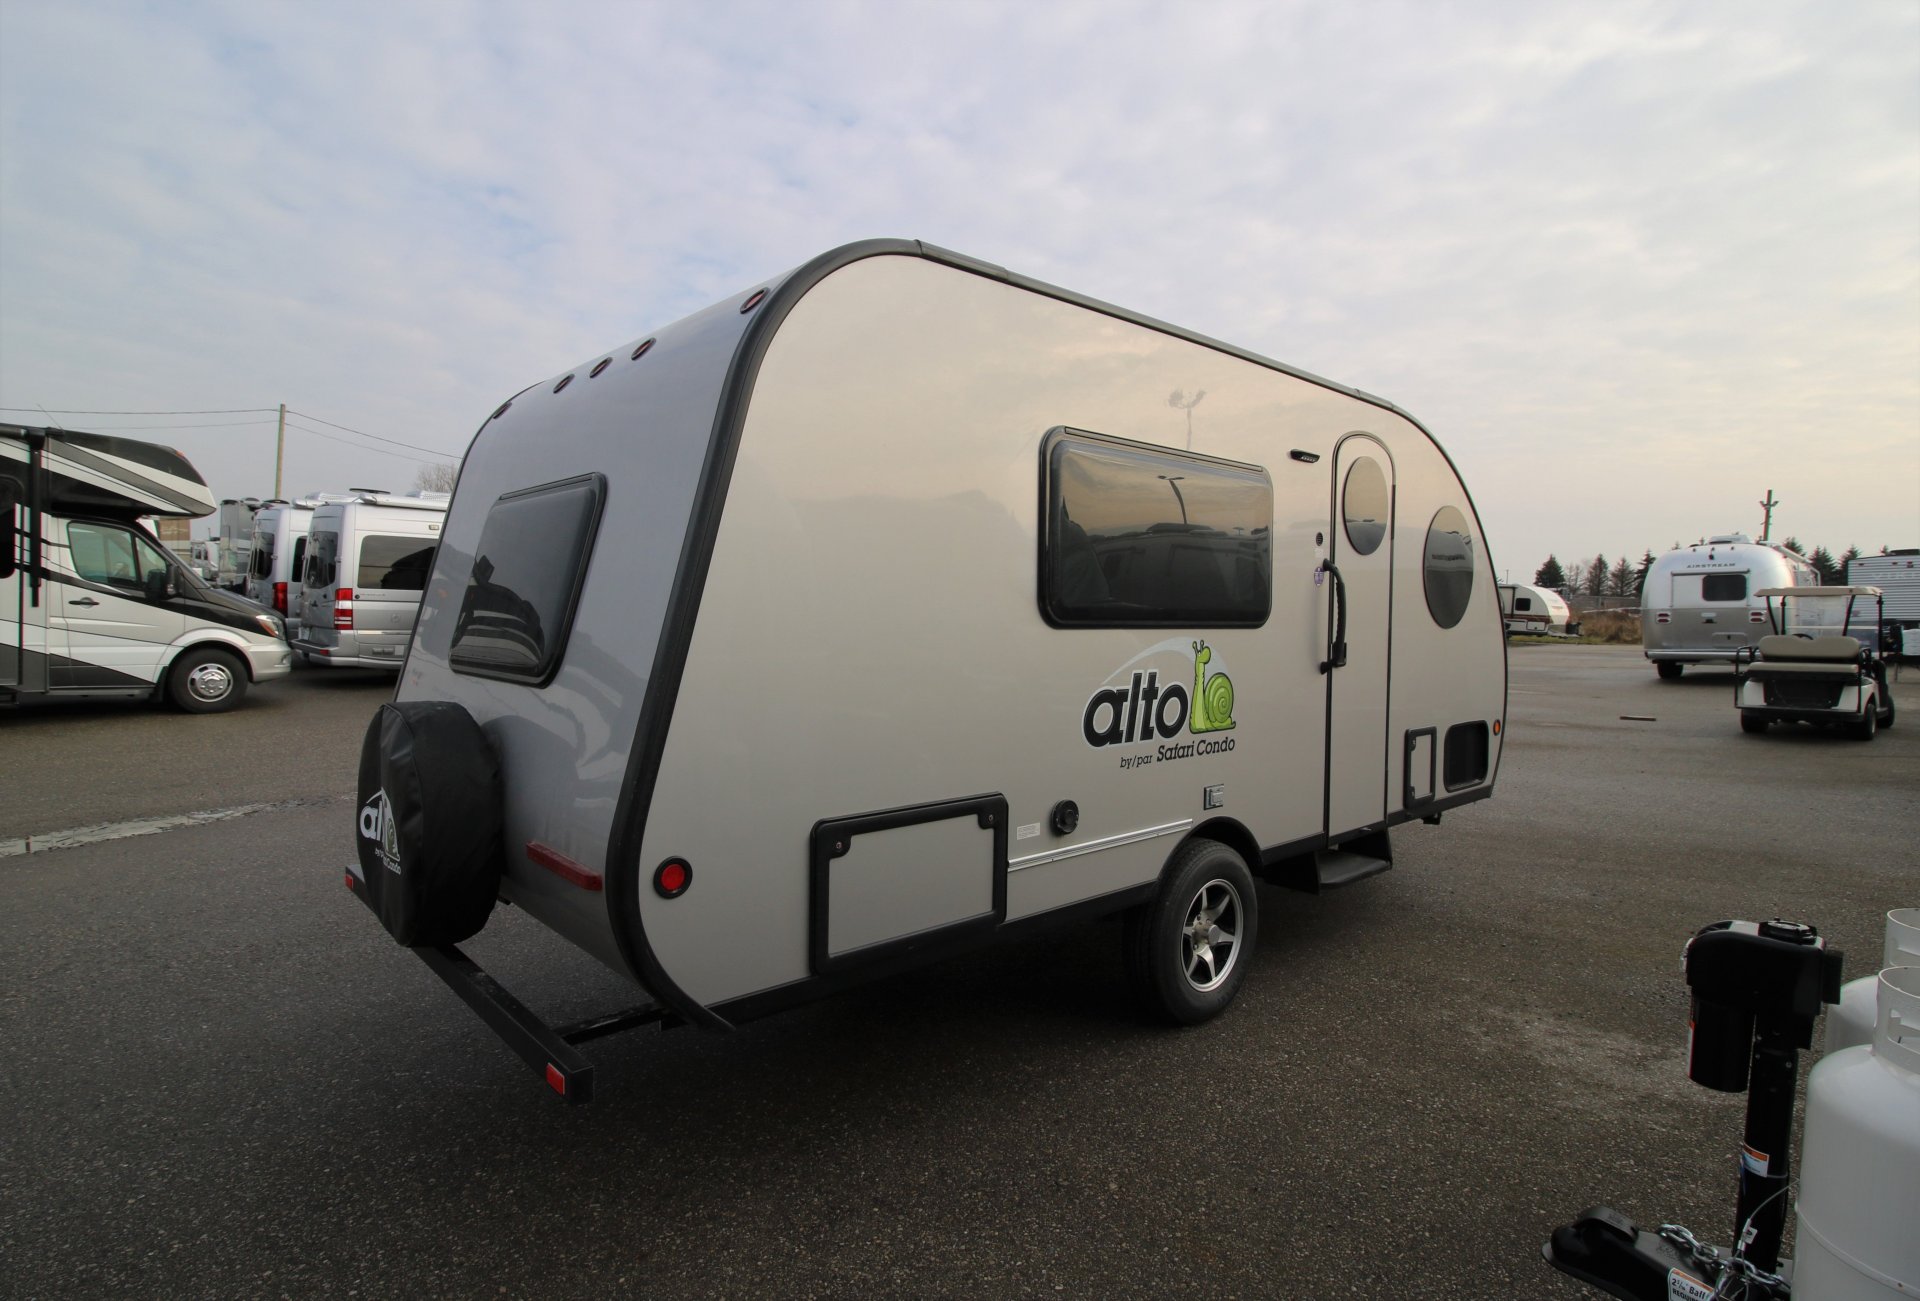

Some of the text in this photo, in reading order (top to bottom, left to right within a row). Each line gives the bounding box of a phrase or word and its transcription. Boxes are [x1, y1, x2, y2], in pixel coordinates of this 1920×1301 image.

[1082, 671, 1189, 748] alto
[1119, 736, 1236, 770] by/par Safari Condo
[1689, 1286, 1706, 1300] Ball
